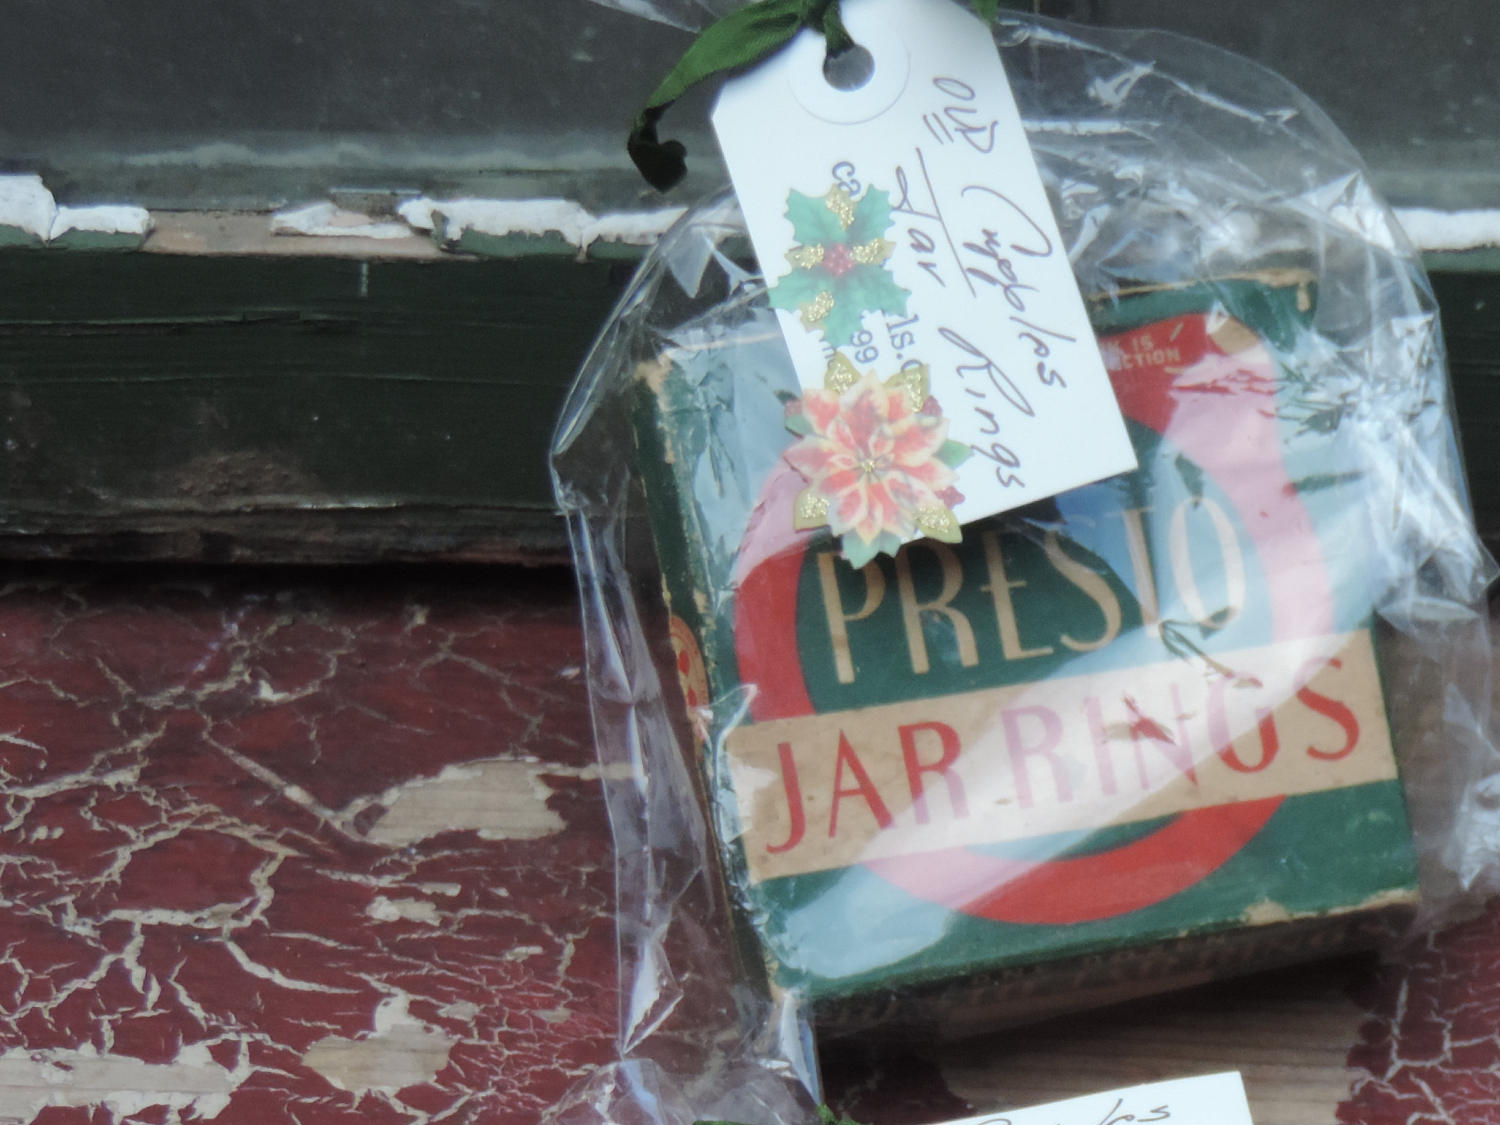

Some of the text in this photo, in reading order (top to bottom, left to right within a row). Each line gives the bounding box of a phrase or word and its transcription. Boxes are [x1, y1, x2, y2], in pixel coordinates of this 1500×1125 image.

[817, 495, 1246, 684] PRESTO
[766, 656, 1361, 855] JAR RINGS
